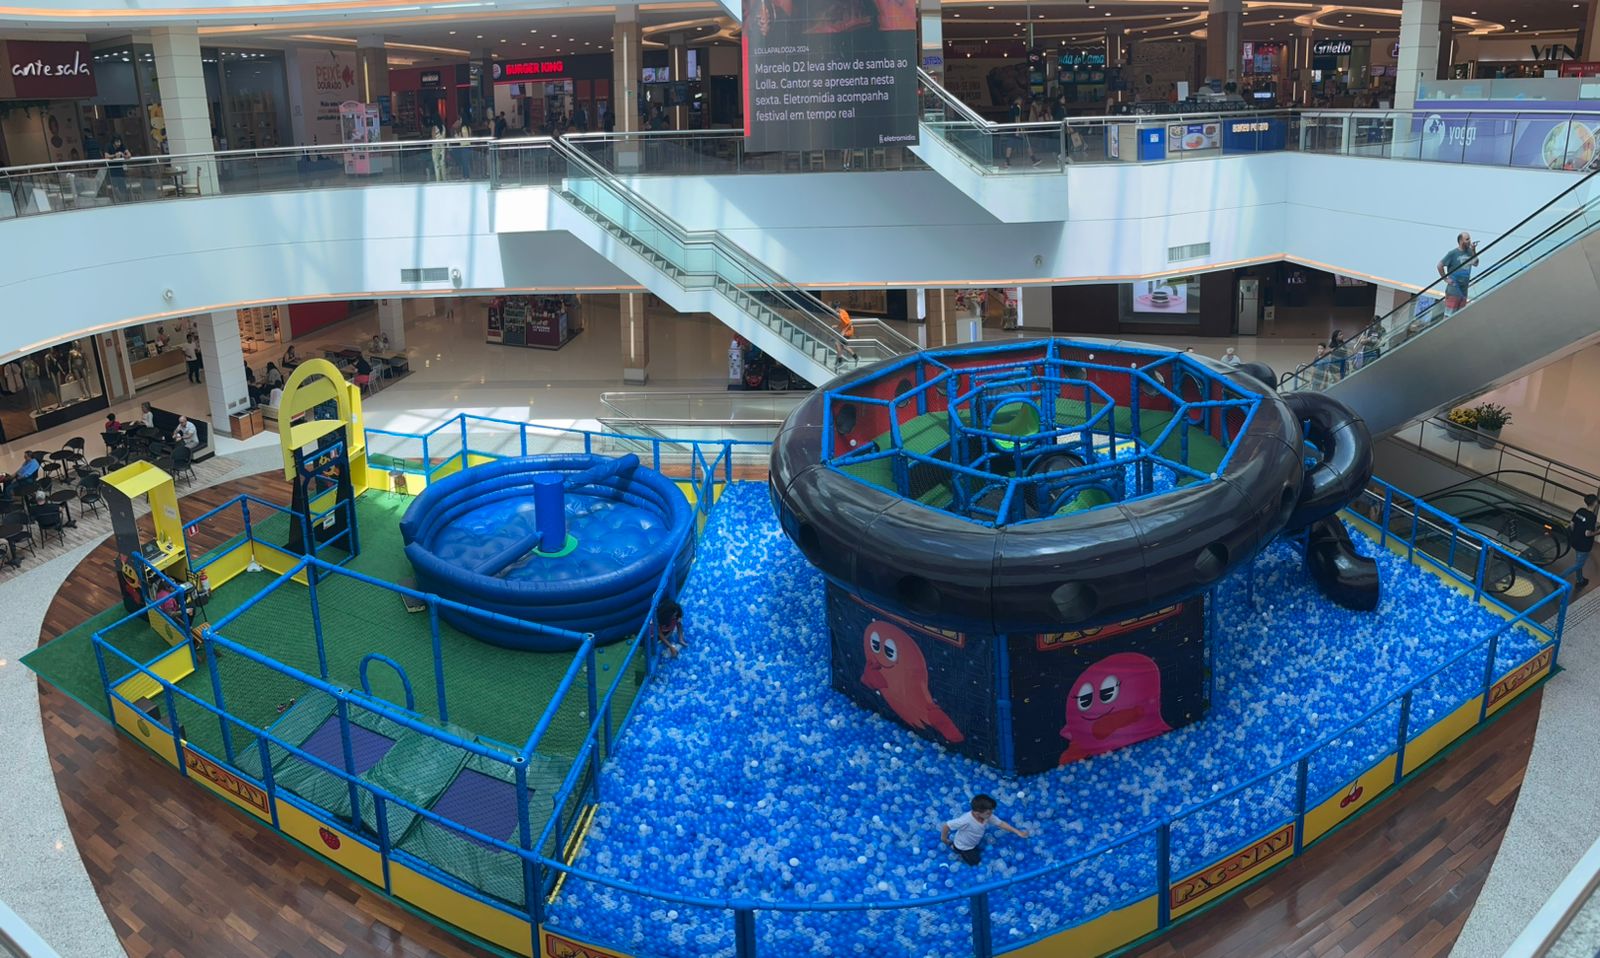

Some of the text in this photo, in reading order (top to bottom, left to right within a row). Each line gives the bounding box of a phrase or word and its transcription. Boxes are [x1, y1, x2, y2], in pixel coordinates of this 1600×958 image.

[754, 45, 810, 55] LOLLAPALOOZA 2024
[505, 60, 564, 76] BURGER KING
[755, 57, 908, 74] Marcelo D2 leva show de samba ao
[755, 75, 895, 90] Lolla. Cantor se apresenta nesta
[755, 90, 889, 106] sexta. Eletromidia acompanha
[756, 108, 856, 121] festival em tempo real
[883, 134, 916, 143] eletromidia
[1449, 126, 1477, 146] yoggi
[185, 751, 266, 809] PAC-MAN
[1175, 830, 1290, 904] PAC-MAN
